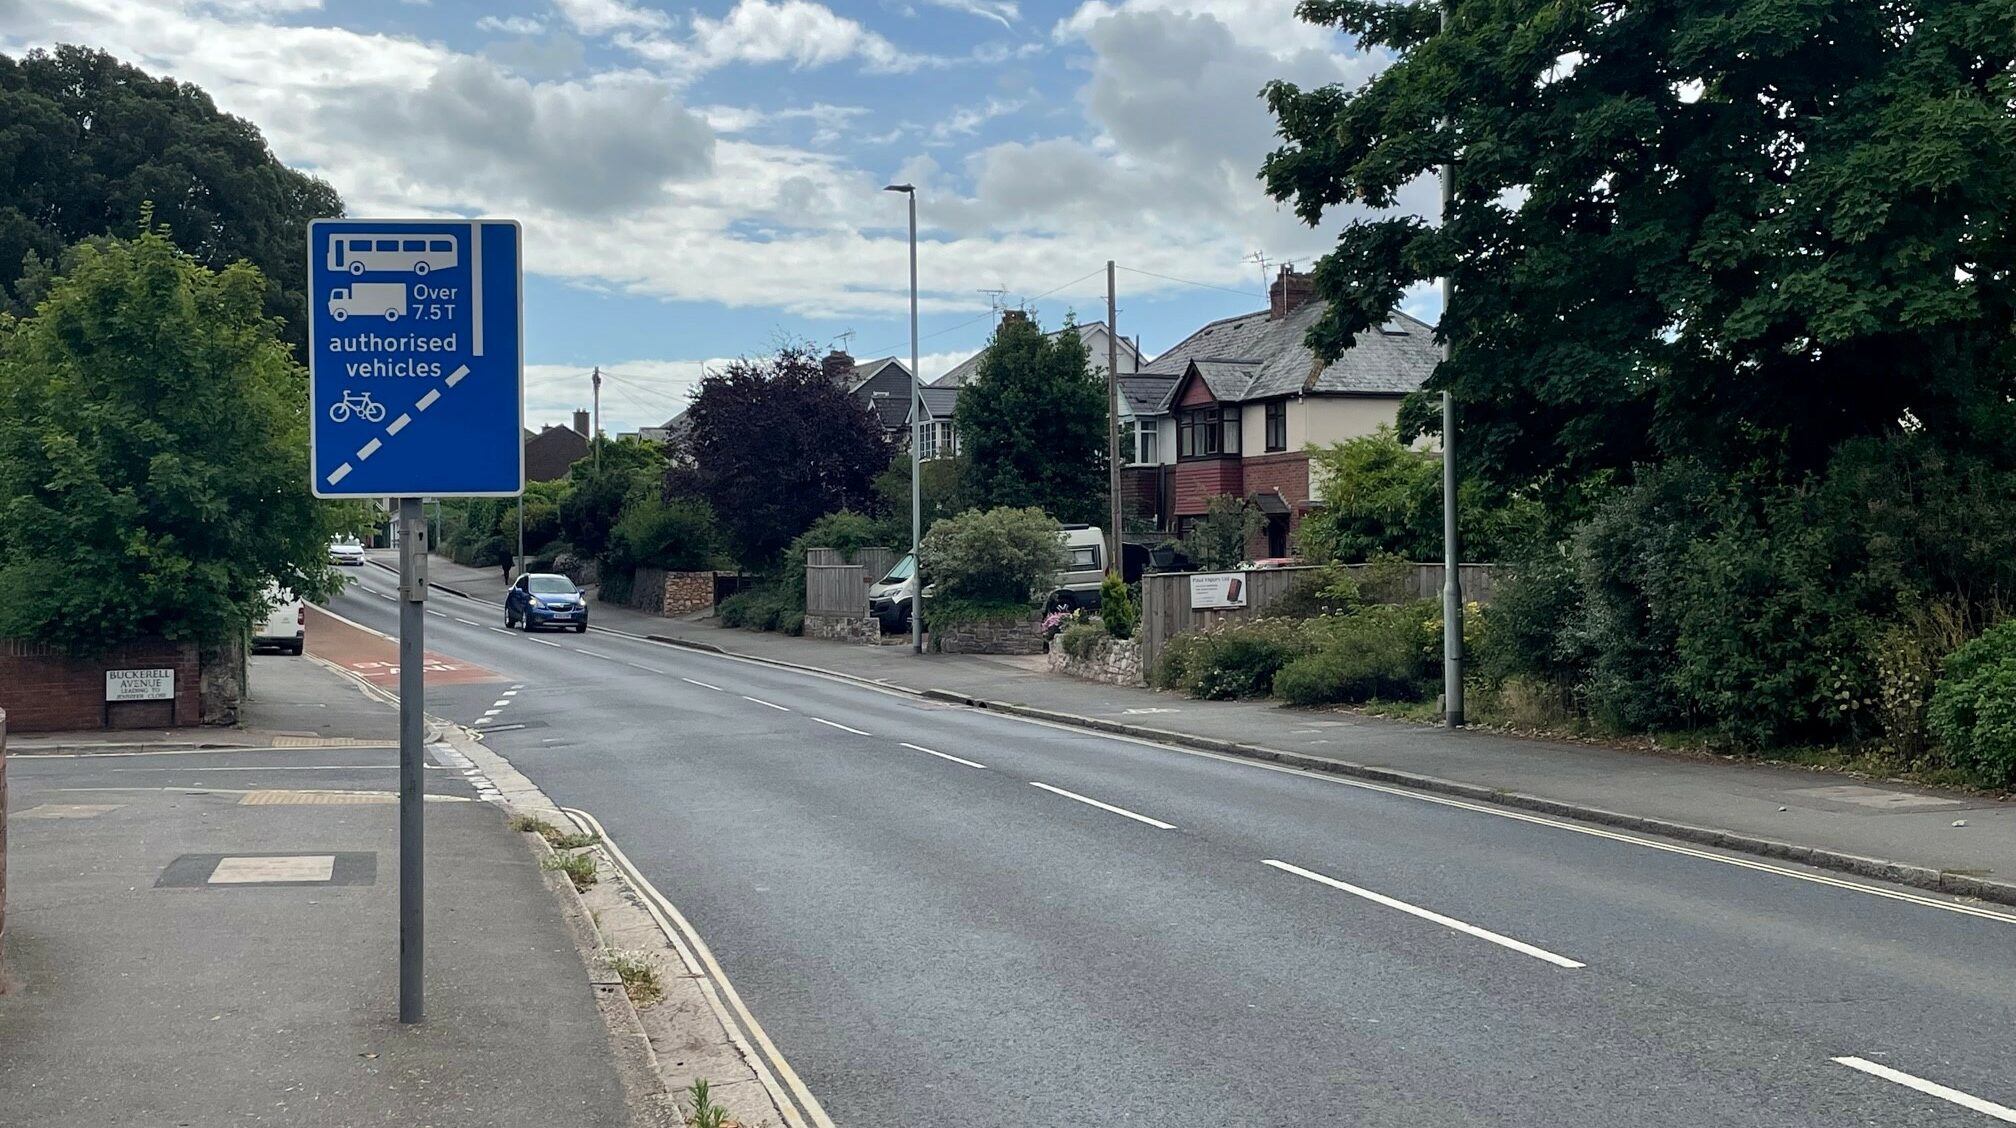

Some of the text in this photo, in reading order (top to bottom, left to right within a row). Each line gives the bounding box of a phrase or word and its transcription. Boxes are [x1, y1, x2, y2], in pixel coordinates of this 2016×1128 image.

[413, 283, 458, 300] Over
[329, 333, 457, 352] authorised
[346, 358, 442, 377] vehicles
[109, 670, 170, 679] BUCKERELL
[120, 679, 162, 688] AVENUE
